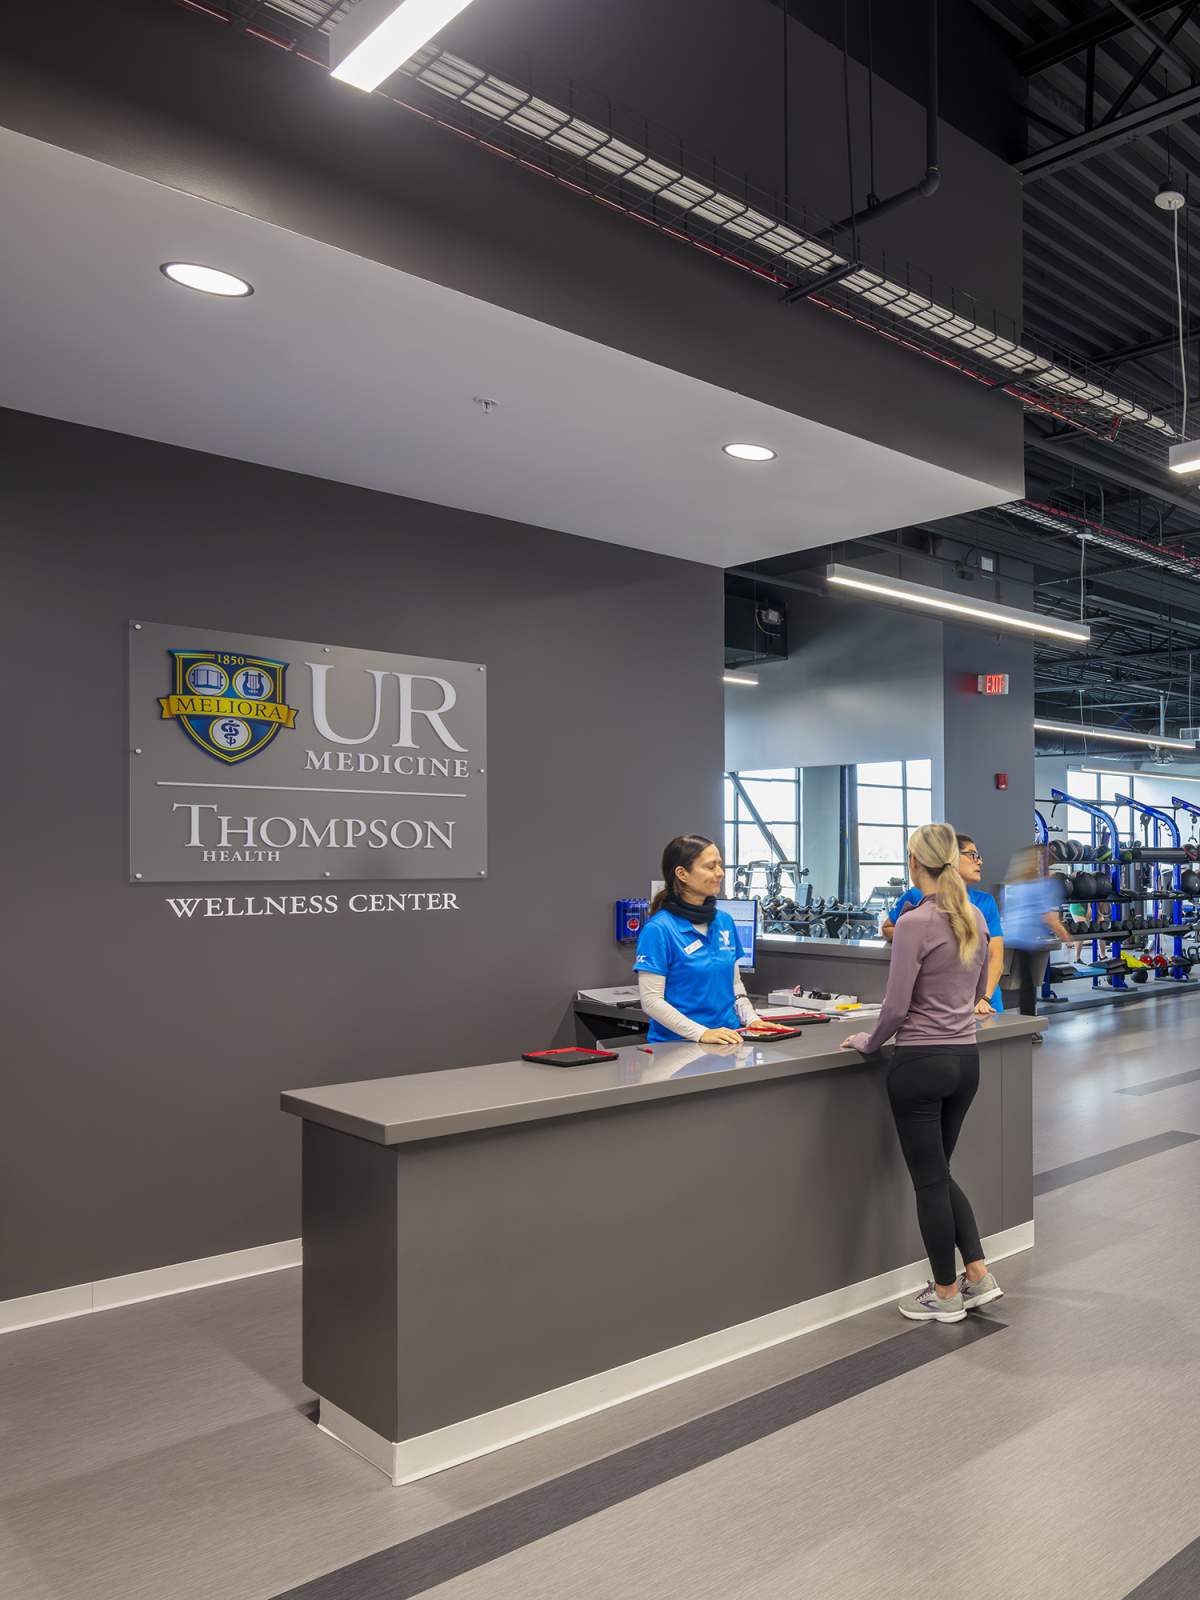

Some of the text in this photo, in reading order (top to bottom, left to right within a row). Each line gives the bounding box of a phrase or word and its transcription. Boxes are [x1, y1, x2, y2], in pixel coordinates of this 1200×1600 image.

[216, 654, 245, 666] 1850
[986, 674, 1003, 694] EXIT
[175, 698, 283, 720] MELIORA
[304, 662, 469, 752] UR
[304, 750, 470, 778] MEDICINE
[172, 803, 457, 850] THOMPSON
[203, 850, 281, 863] HEALTH
[165, 892, 460, 918] WELLNESS CENTER
